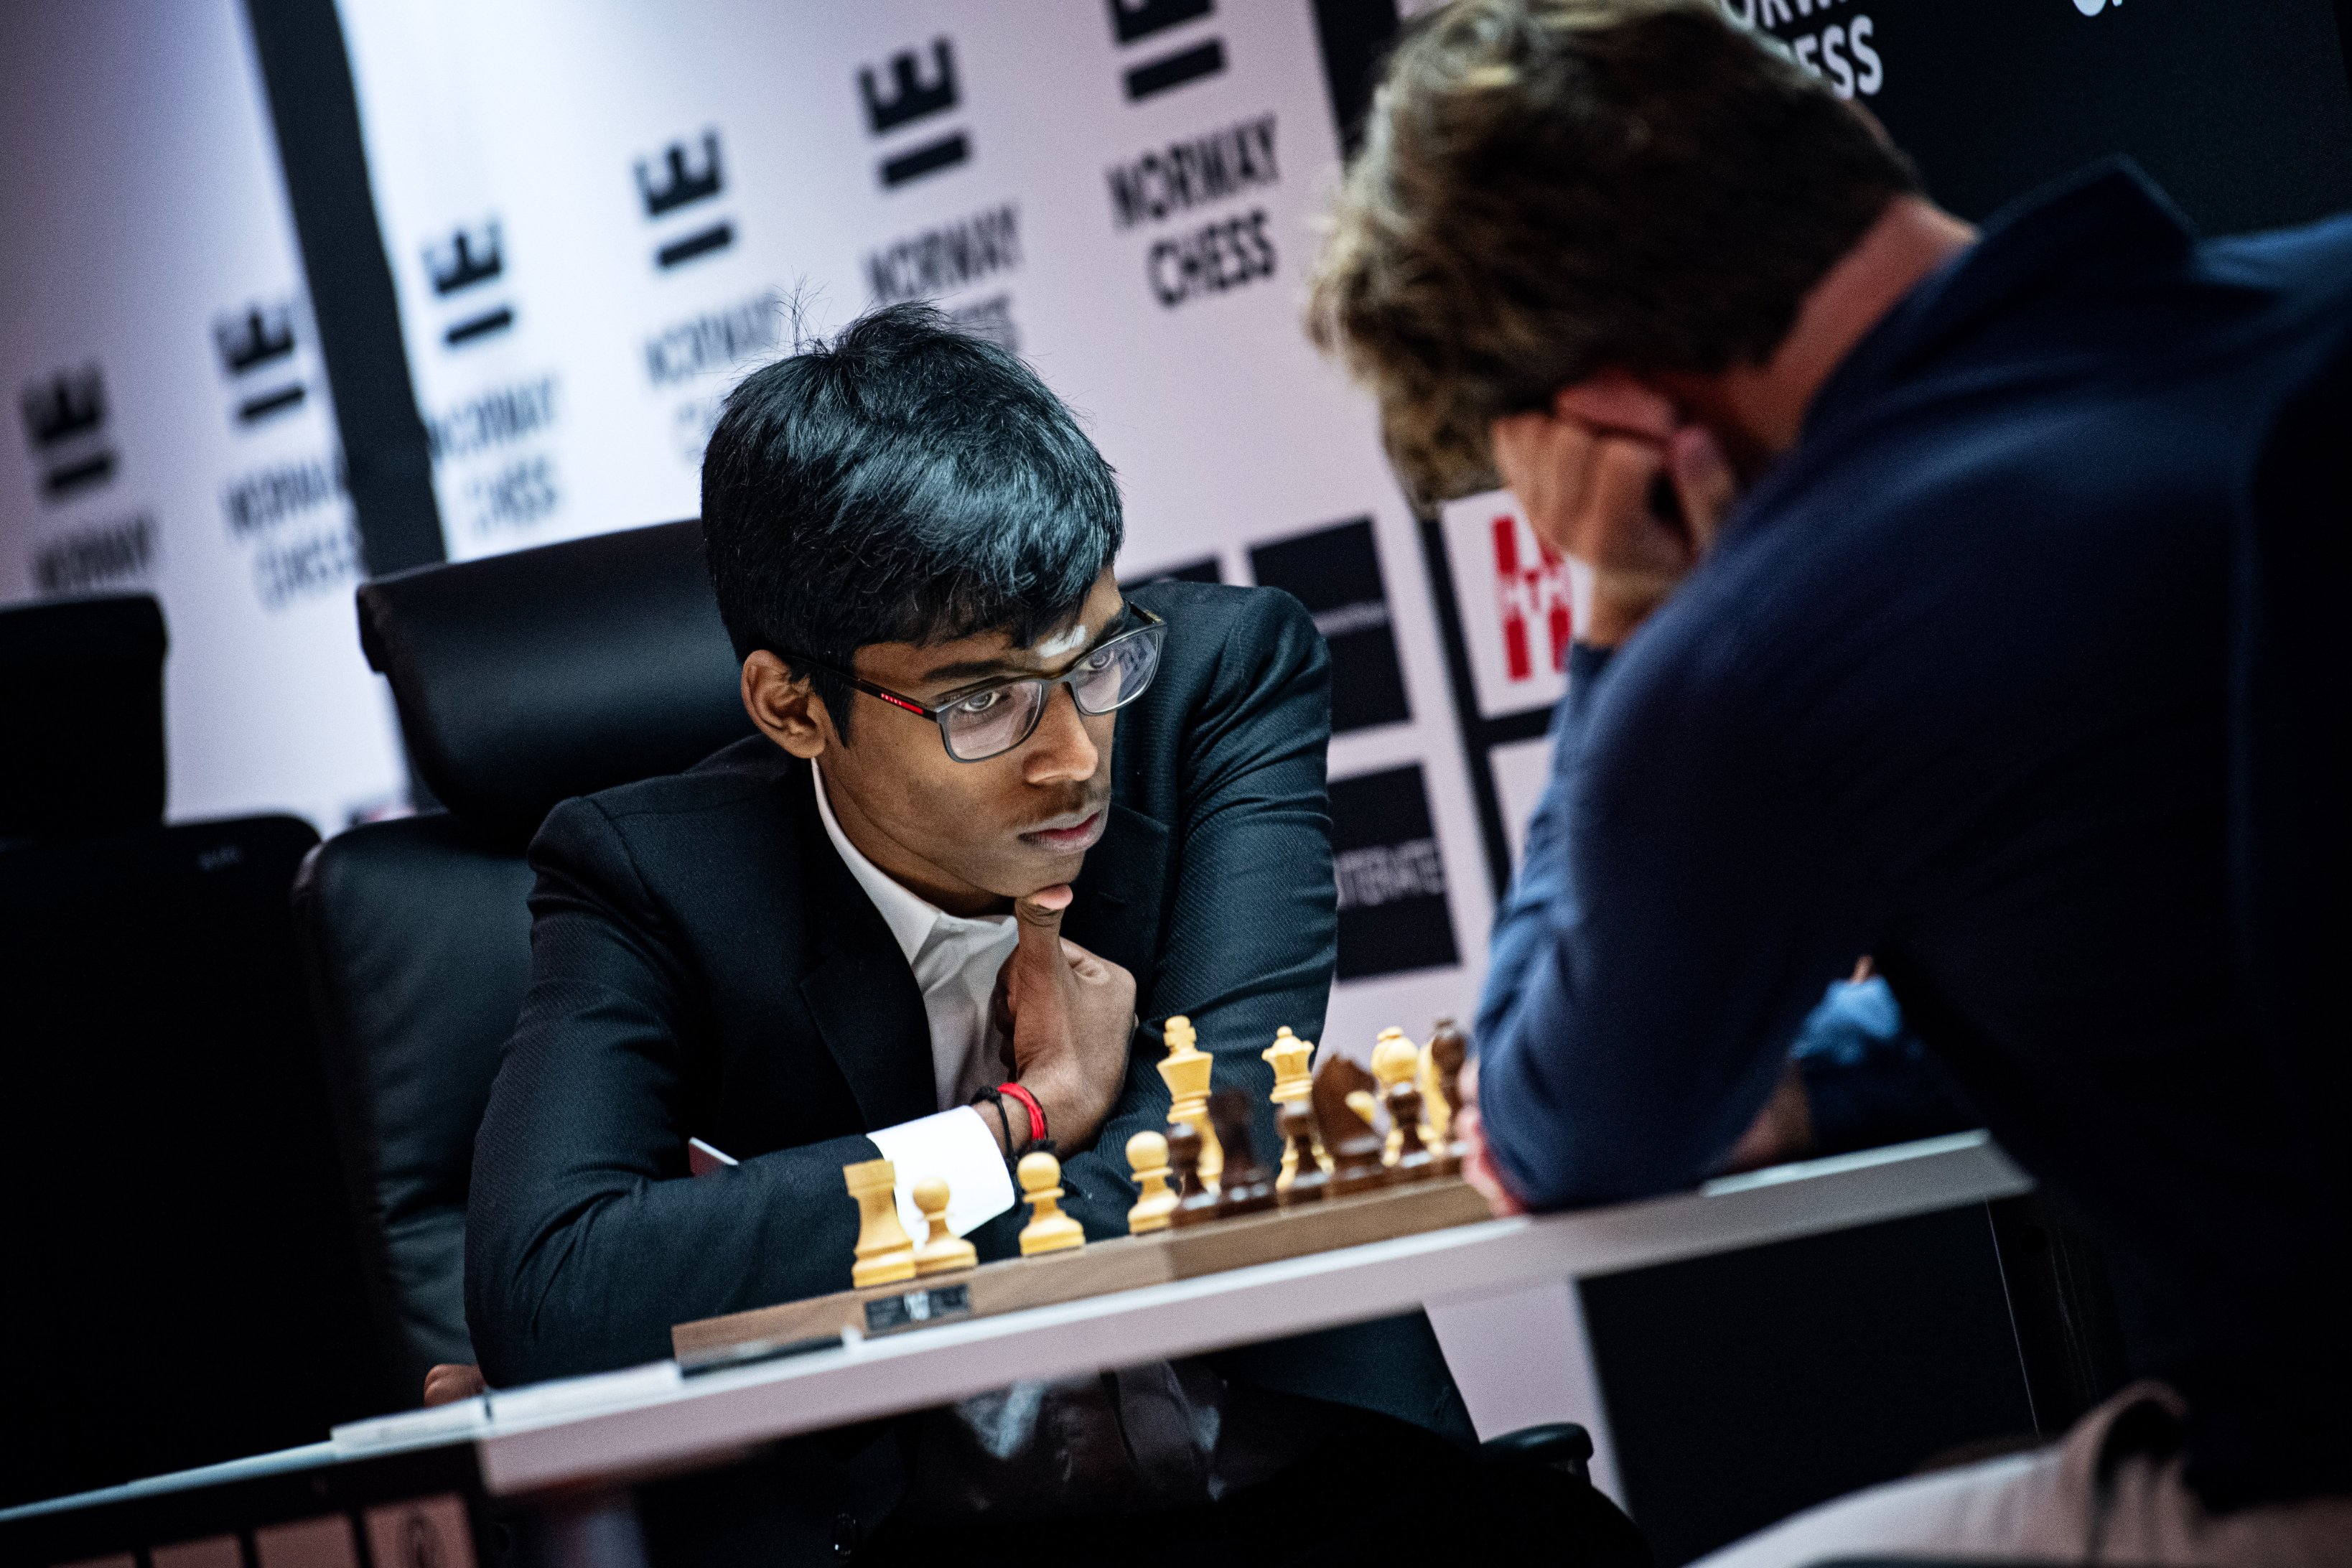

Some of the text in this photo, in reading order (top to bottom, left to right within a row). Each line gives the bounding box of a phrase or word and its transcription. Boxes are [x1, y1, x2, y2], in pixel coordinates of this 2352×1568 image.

[1794, 14, 1884, 101] ESS
[1106, 113, 1278, 230] NORWAY
[866, 200, 1023, 302] NORWAY
[1148, 208, 1277, 307] CHESS
